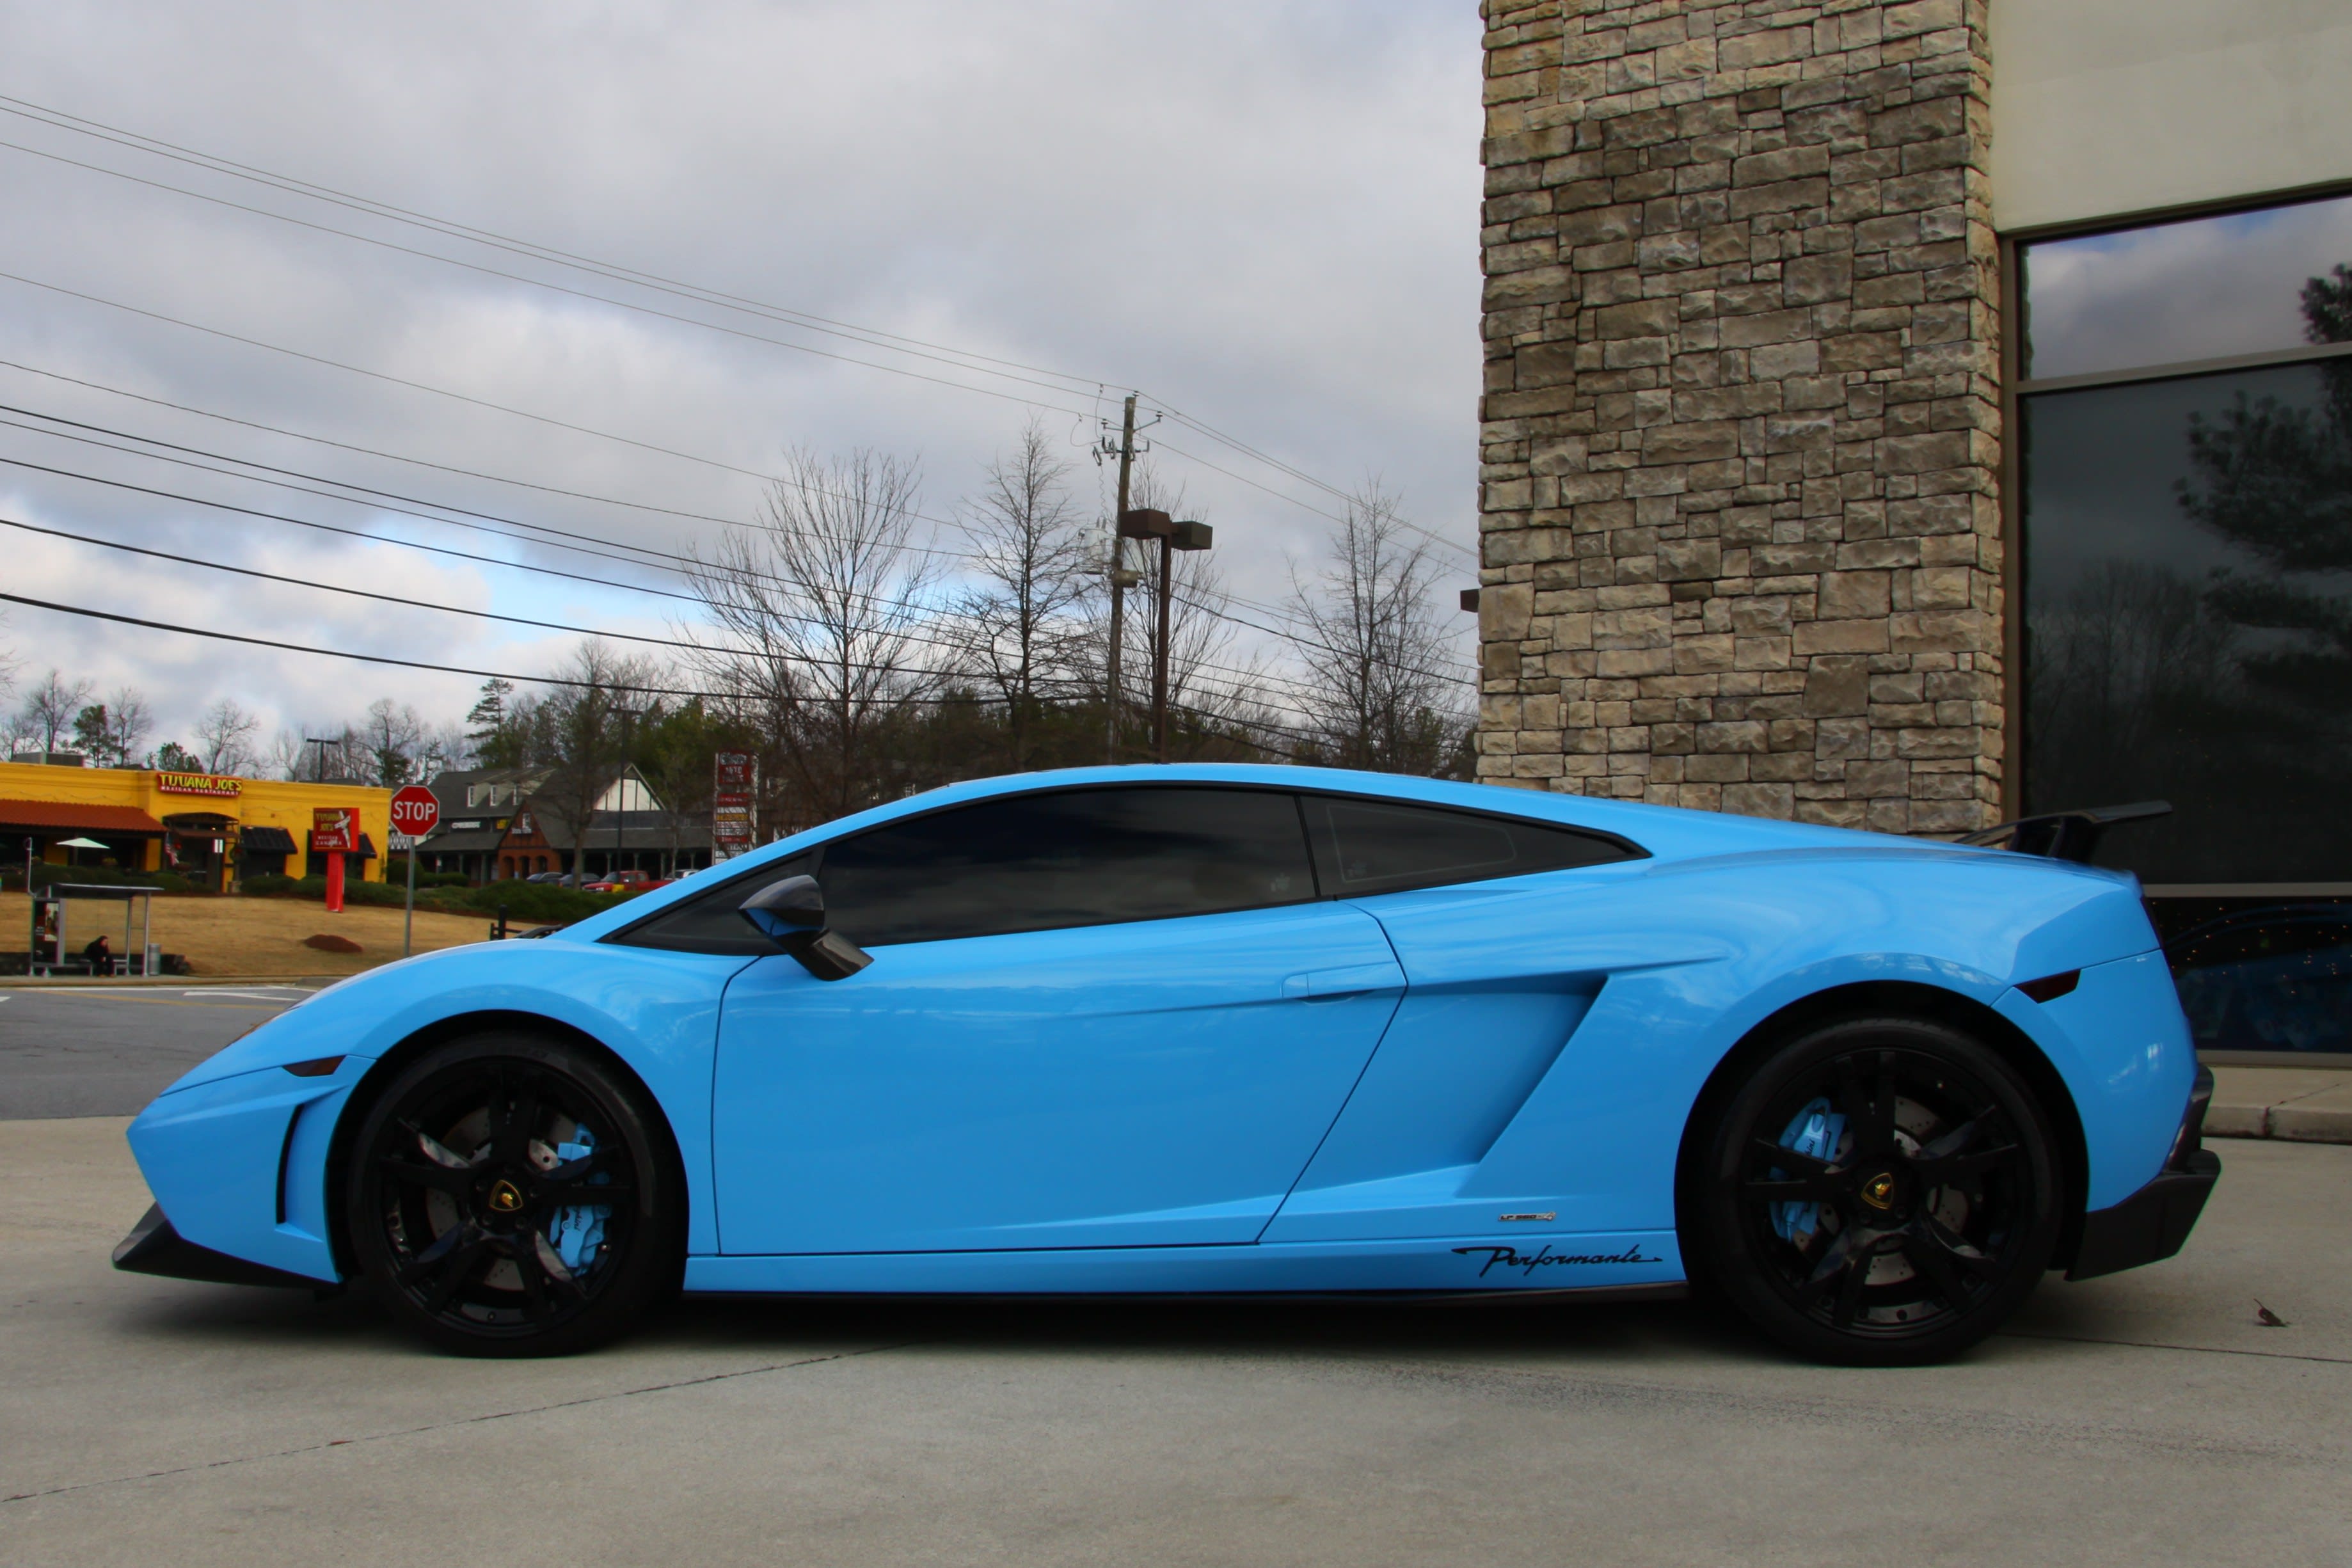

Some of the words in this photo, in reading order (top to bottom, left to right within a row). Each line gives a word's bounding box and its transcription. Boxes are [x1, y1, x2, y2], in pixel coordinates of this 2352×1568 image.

[159, 774, 212, 789] TIJUANA
[393, 800, 436, 821] STOP
[1450, 1244, 1663, 1278] Performante
